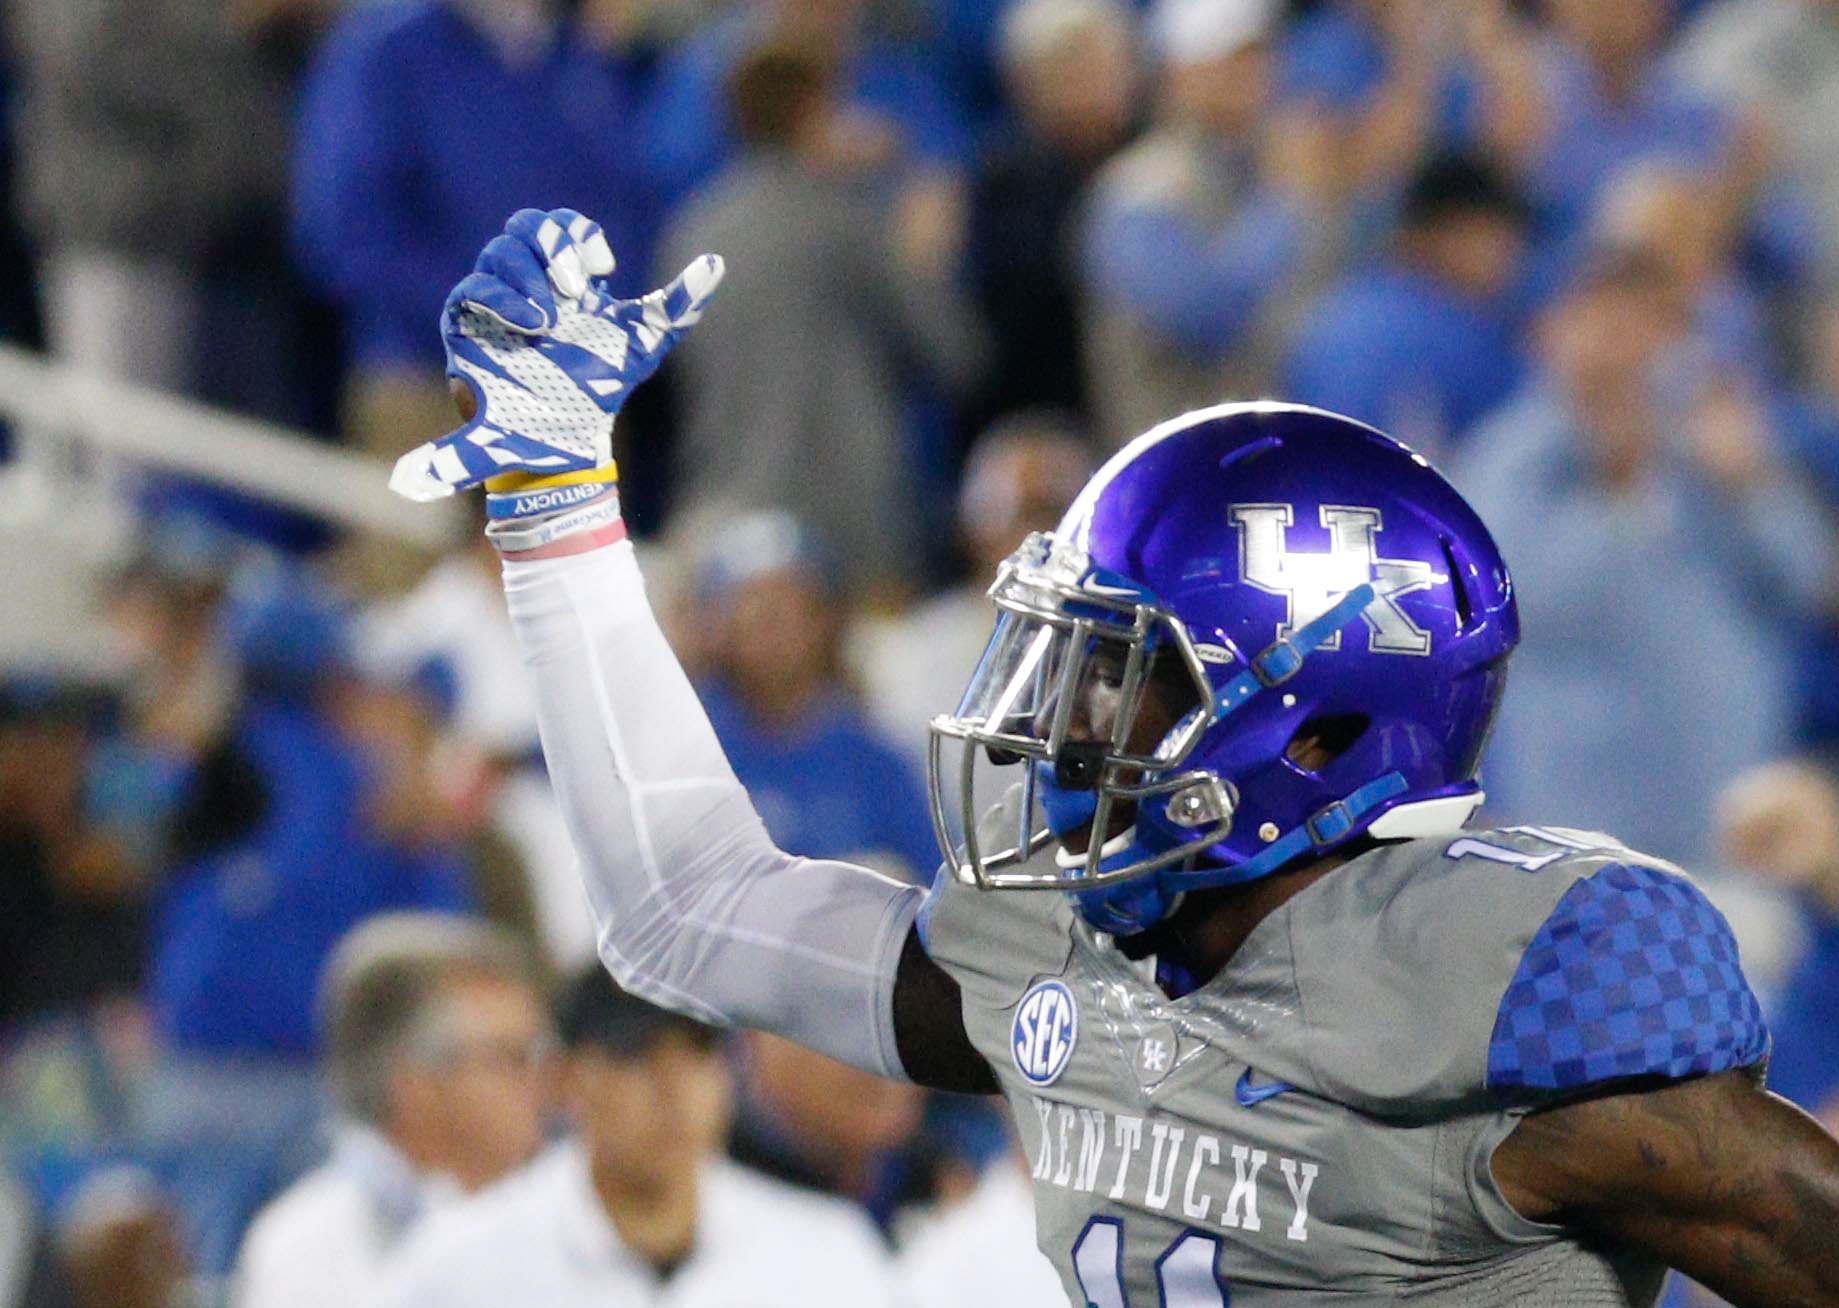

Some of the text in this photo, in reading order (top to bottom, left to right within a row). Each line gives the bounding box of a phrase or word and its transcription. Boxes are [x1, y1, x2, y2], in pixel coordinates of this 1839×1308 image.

[513, 483, 605, 514] KENTUCKY
[1015, 987, 1074, 1078] SEC
[1032, 1096, 1318, 1242] KENTUCKY
